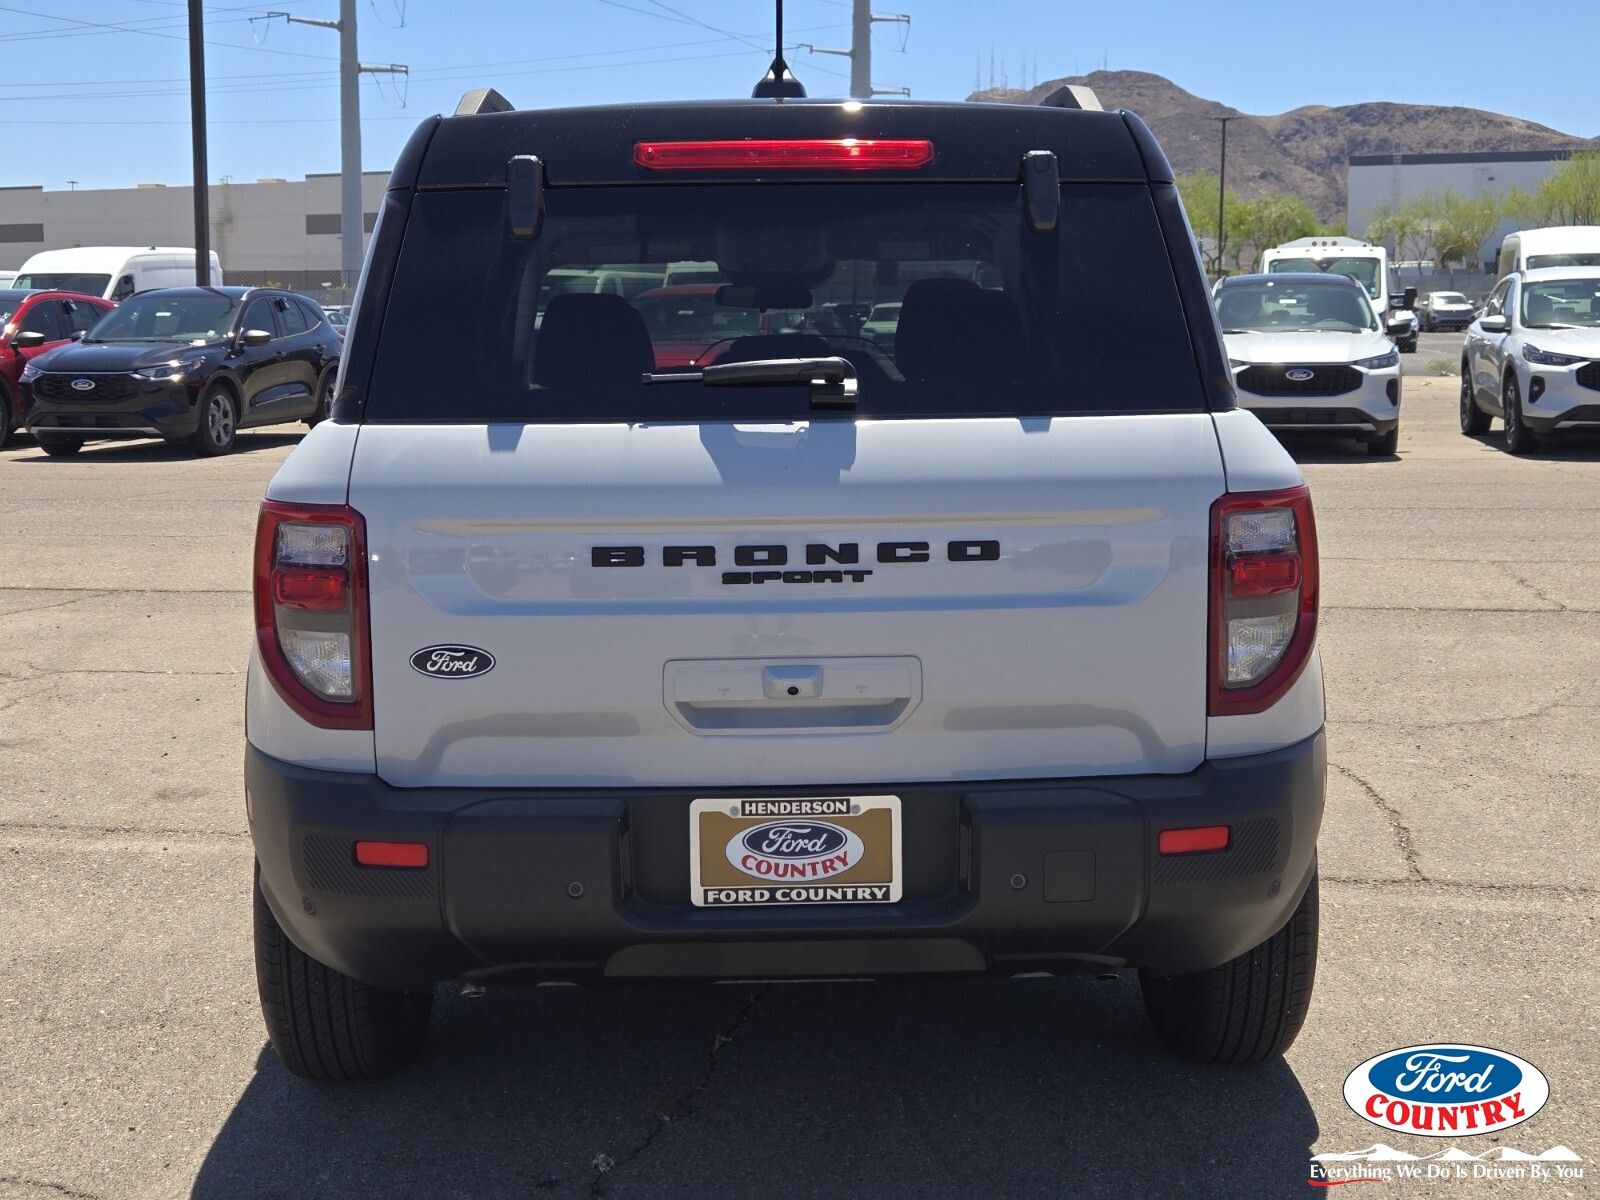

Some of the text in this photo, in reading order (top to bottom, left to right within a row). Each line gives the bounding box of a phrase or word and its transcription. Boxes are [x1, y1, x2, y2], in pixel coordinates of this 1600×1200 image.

[592, 541, 1001, 567] BRONCO
[722, 570, 873, 584] SPORT
[426, 650, 478, 672] Ford
[744, 801, 848, 815] HENDERSON
[762, 827, 828, 853] Ford
[741, 851, 850, 879] COUNTRY
[706, 887, 887, 903] FORD COUNTRY
